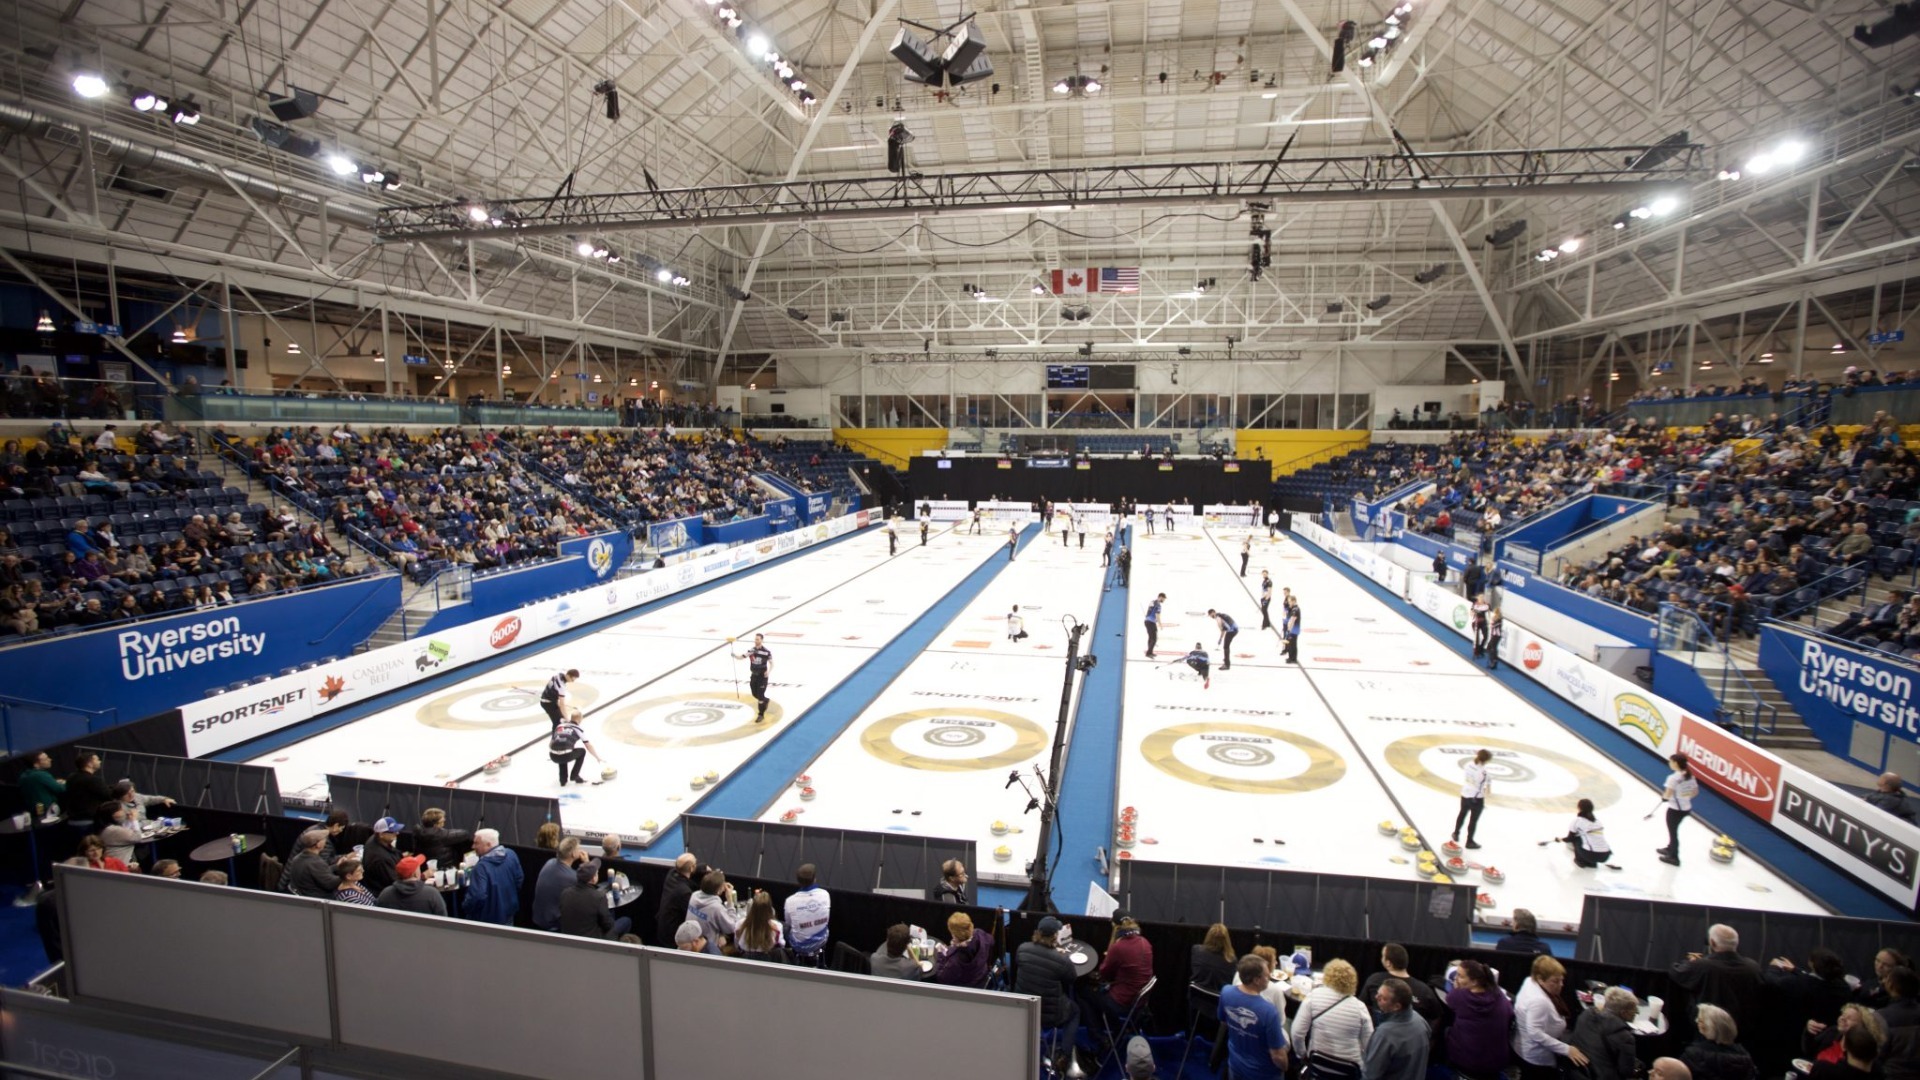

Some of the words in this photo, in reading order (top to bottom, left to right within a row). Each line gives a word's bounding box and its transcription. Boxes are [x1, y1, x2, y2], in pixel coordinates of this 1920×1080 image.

[118, 616, 240, 658] Ryerson
[428, 642, 449, 657] Dump
[491, 617, 521, 645] BOOST
[122, 632, 266, 681] University
[352, 658, 405, 681] CANADIAN
[370, 673, 391, 686] BEEF
[1802, 640, 1912, 700] Ryerson
[191, 688, 306, 734] SPORTSNET
[1799, 670, 1920, 743] Universit
[1680, 735, 1758, 795] MERIDIAN
[1785, 790, 1908, 877] PINTY'S
